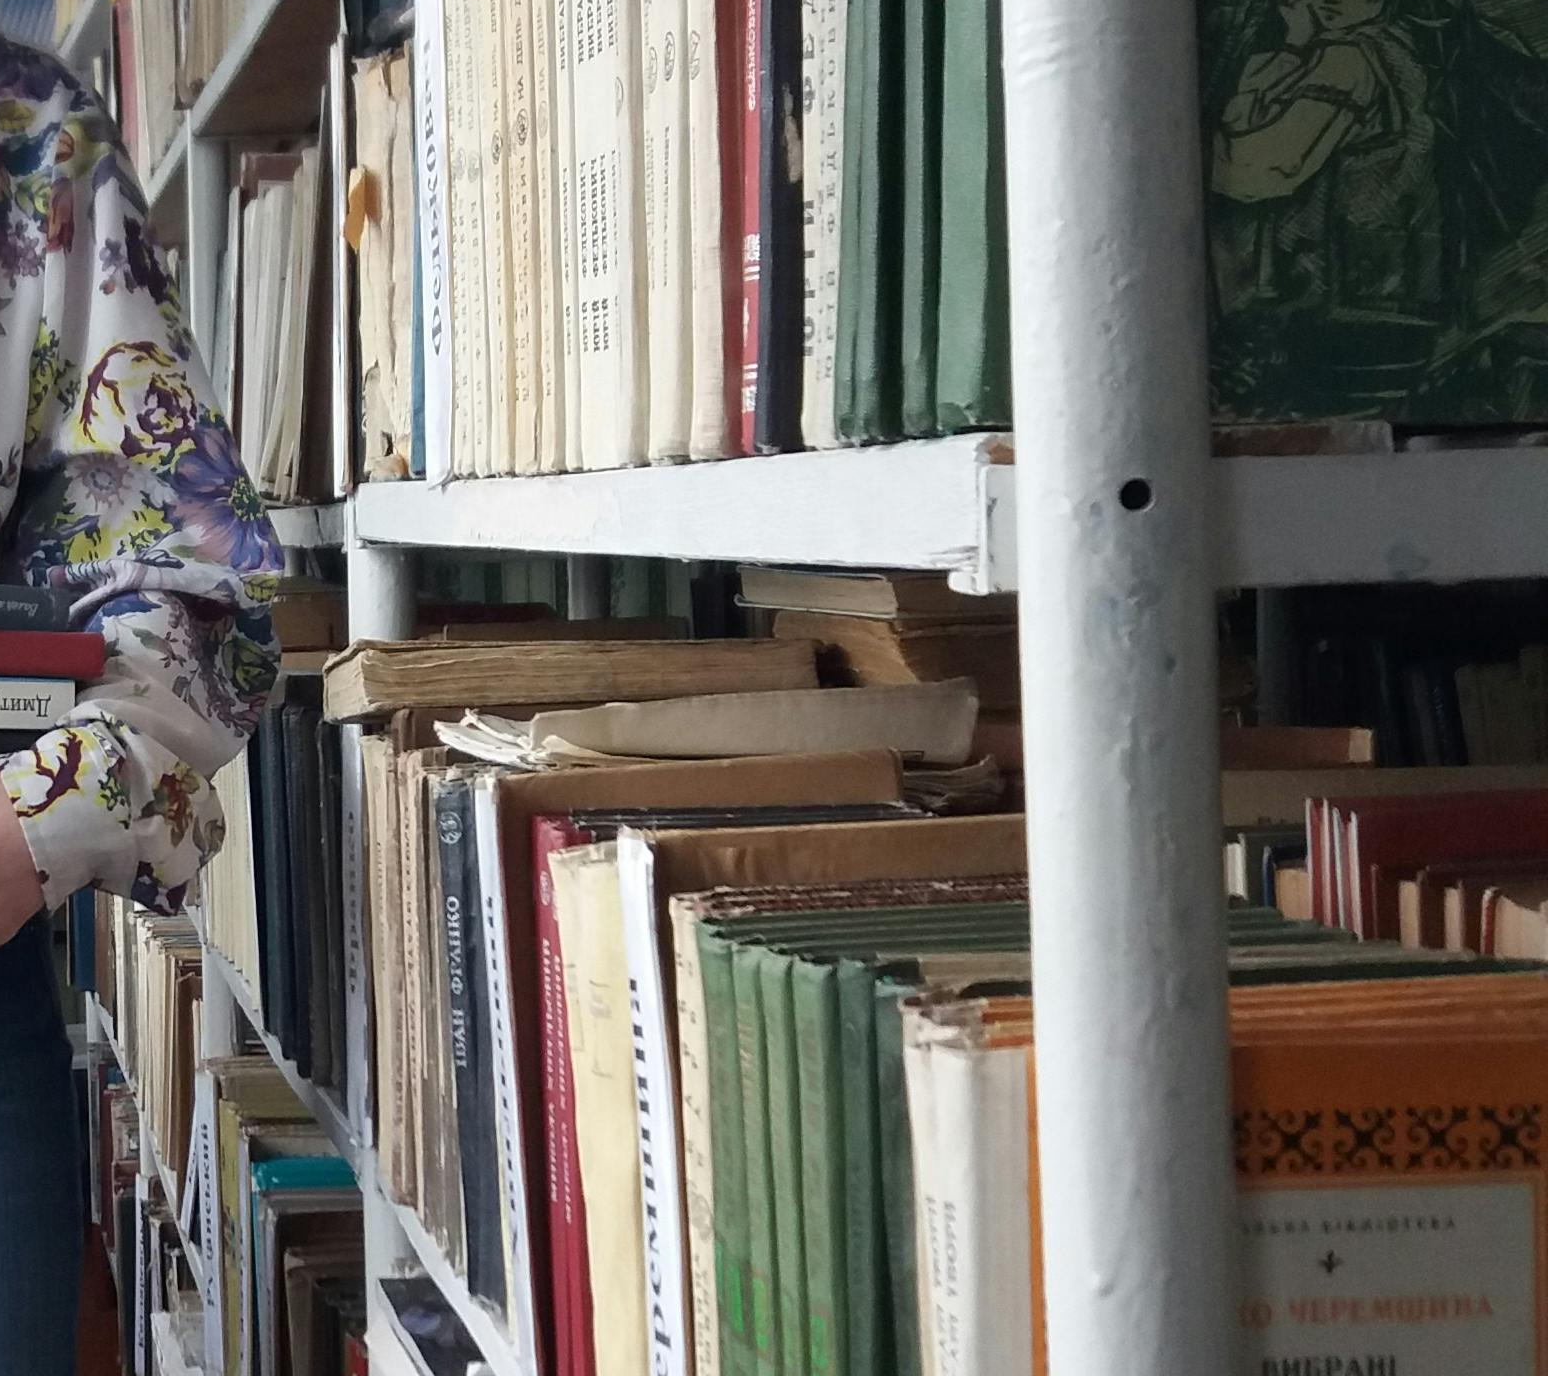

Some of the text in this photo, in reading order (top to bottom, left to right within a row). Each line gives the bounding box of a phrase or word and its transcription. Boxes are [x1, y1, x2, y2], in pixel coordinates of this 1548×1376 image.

[447, 895, 468, 1069] ІВАН ФРАНКО
[1289, 1295, 1494, 1323] ЧЕРЕМШИНА
